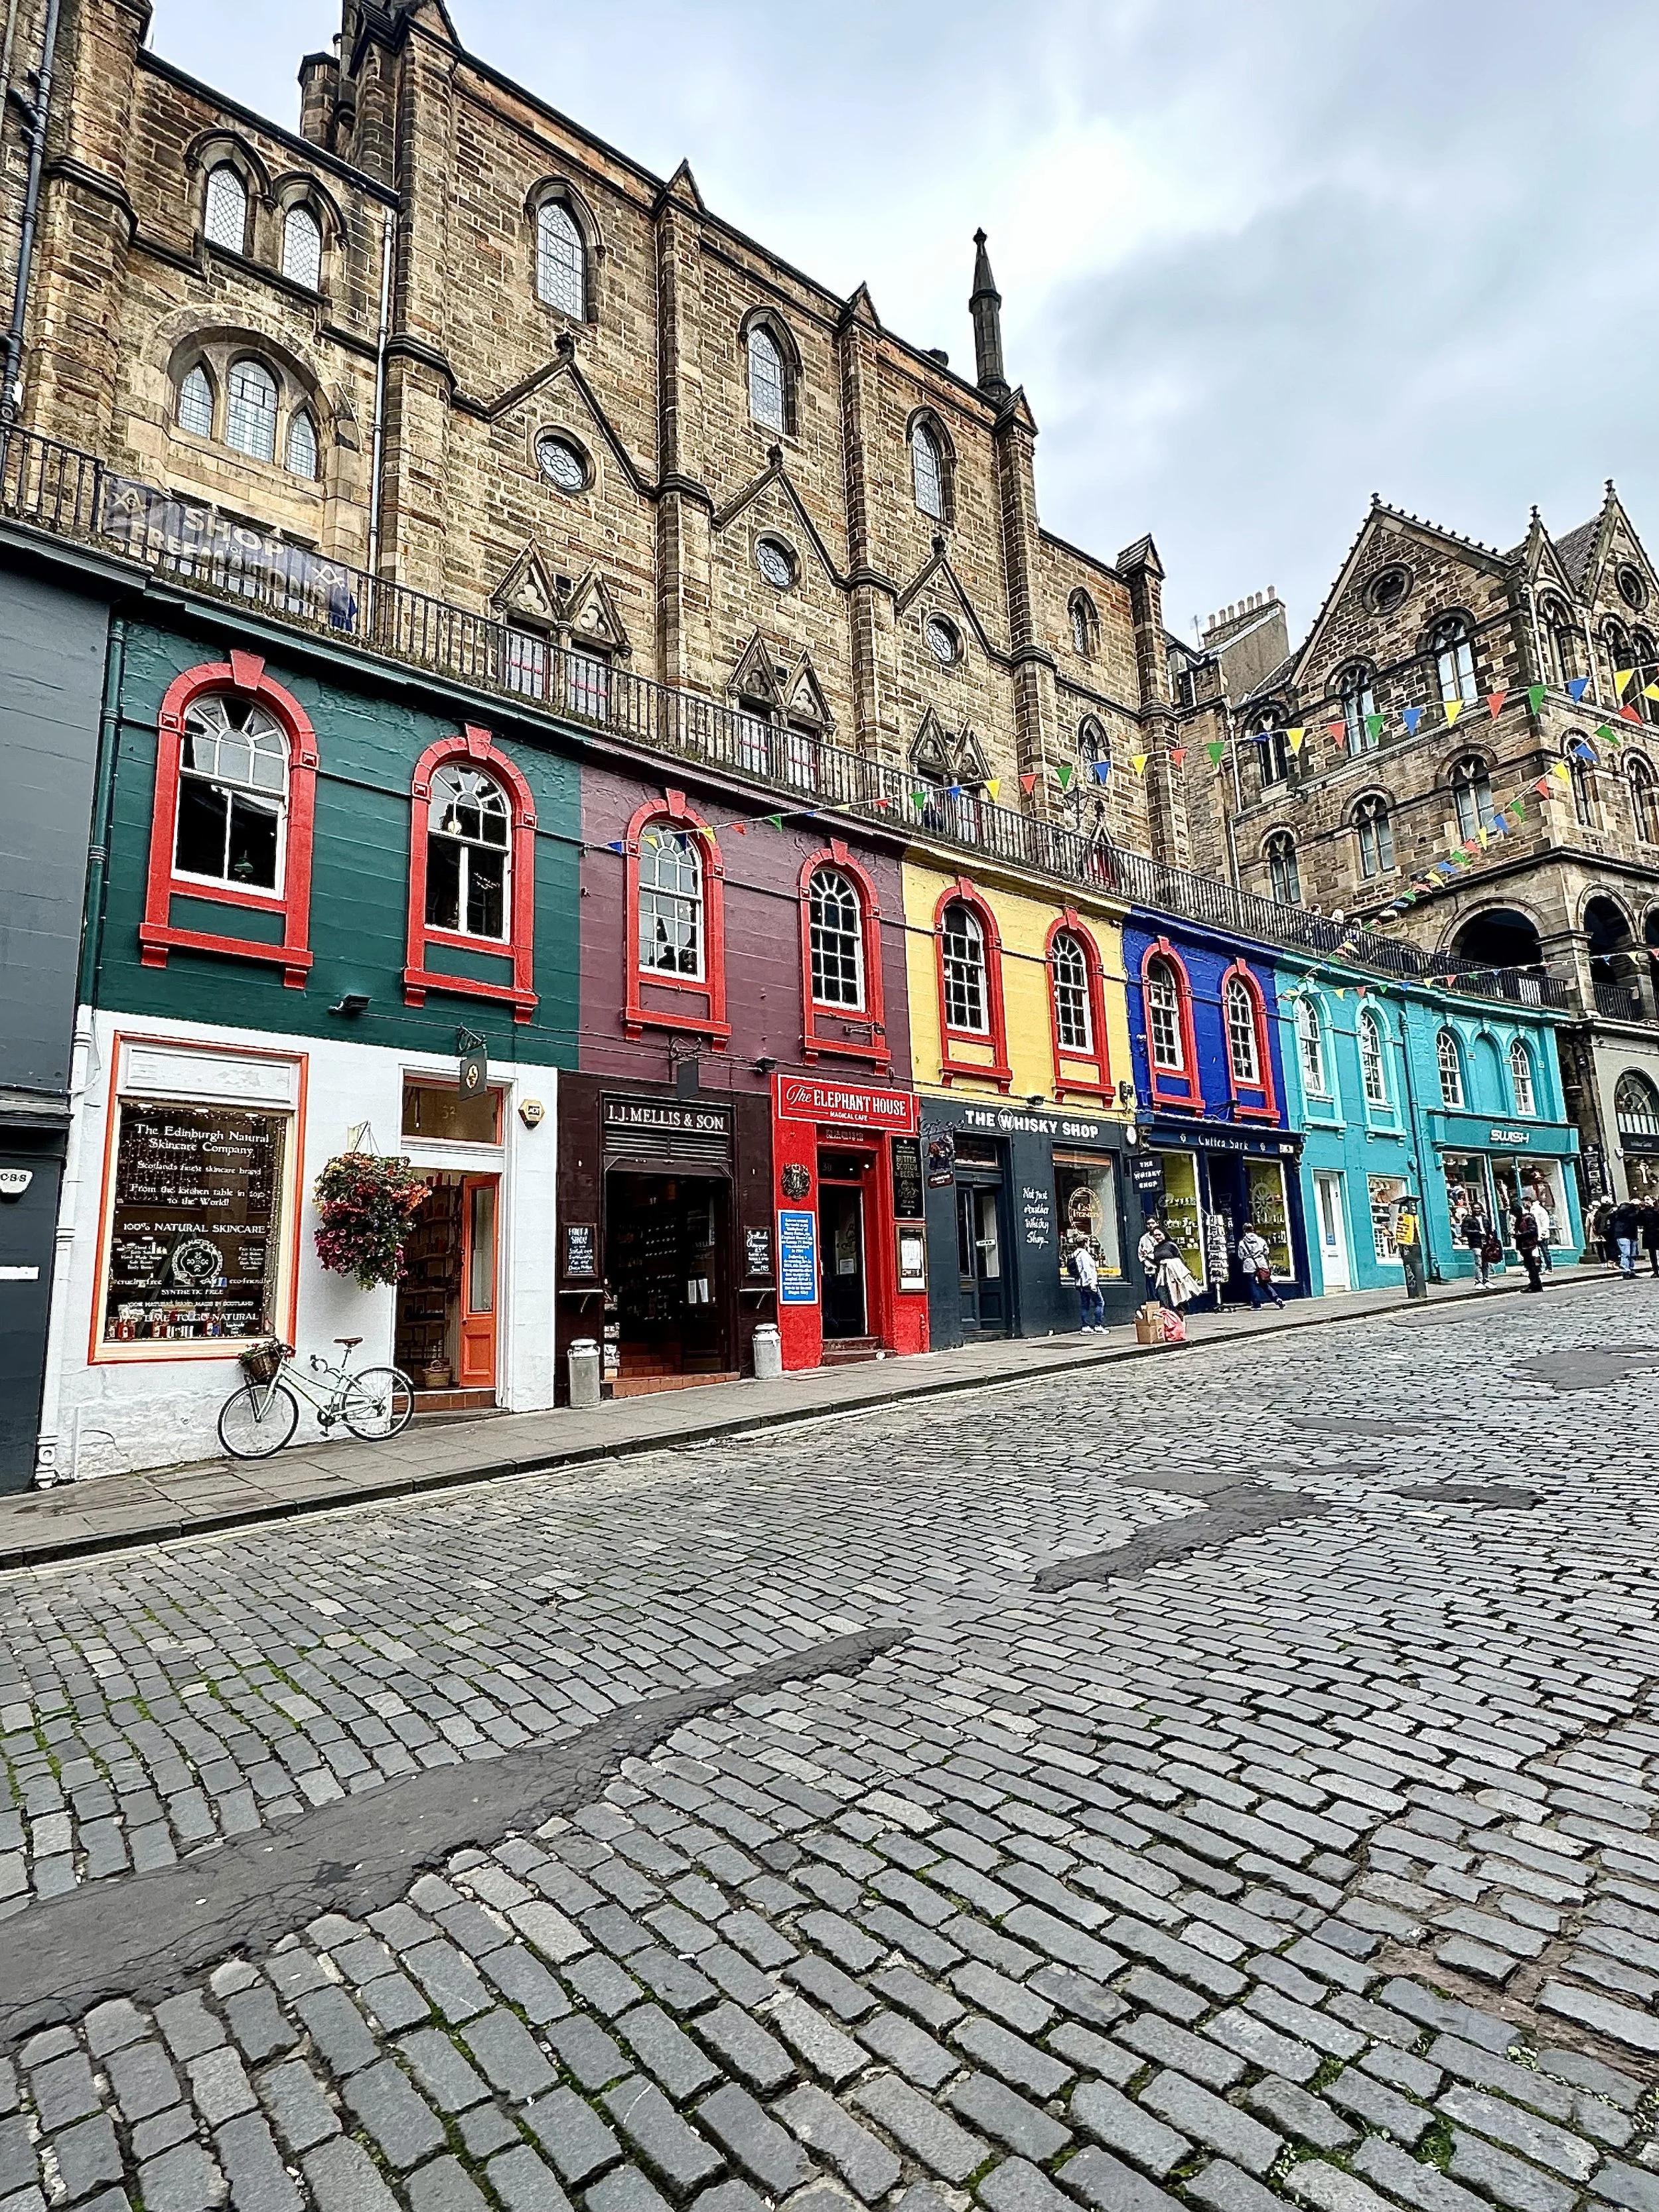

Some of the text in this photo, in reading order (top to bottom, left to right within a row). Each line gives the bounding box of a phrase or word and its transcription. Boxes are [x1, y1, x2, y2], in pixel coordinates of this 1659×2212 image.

[182, 506, 284, 558] SHOP
[226, 541, 244, 555] for
[130, 521, 326, 607] FREEMASONS
[786, 1084, 906, 1116] The ELEPHANT HOUSE
[684, 1114, 693, 1127] &
[697, 1115, 724, 1130] SON
[830, 1111, 853, 1120] MAGICAL
[965, 1110, 1098, 1138] THE WHISKY SHOP
[135, 1124, 269, 1143] The Edinburgh Natural
[1490, 1129, 1529, 1143] SWISH
[149, 1138, 253, 1157] Skincare Company
[1229, 1140, 1249, 1150] Sark
[1133, 1169, 1161, 1180] WHISKY
[129, 1184, 156, 1193] From
[154, 1222, 208, 1233] NATURAL
[212, 1224, 266, 1234] SKINCARE
[177, 1313, 188, 1322] TO
[212, 1313, 259, 1322] NATURAL
